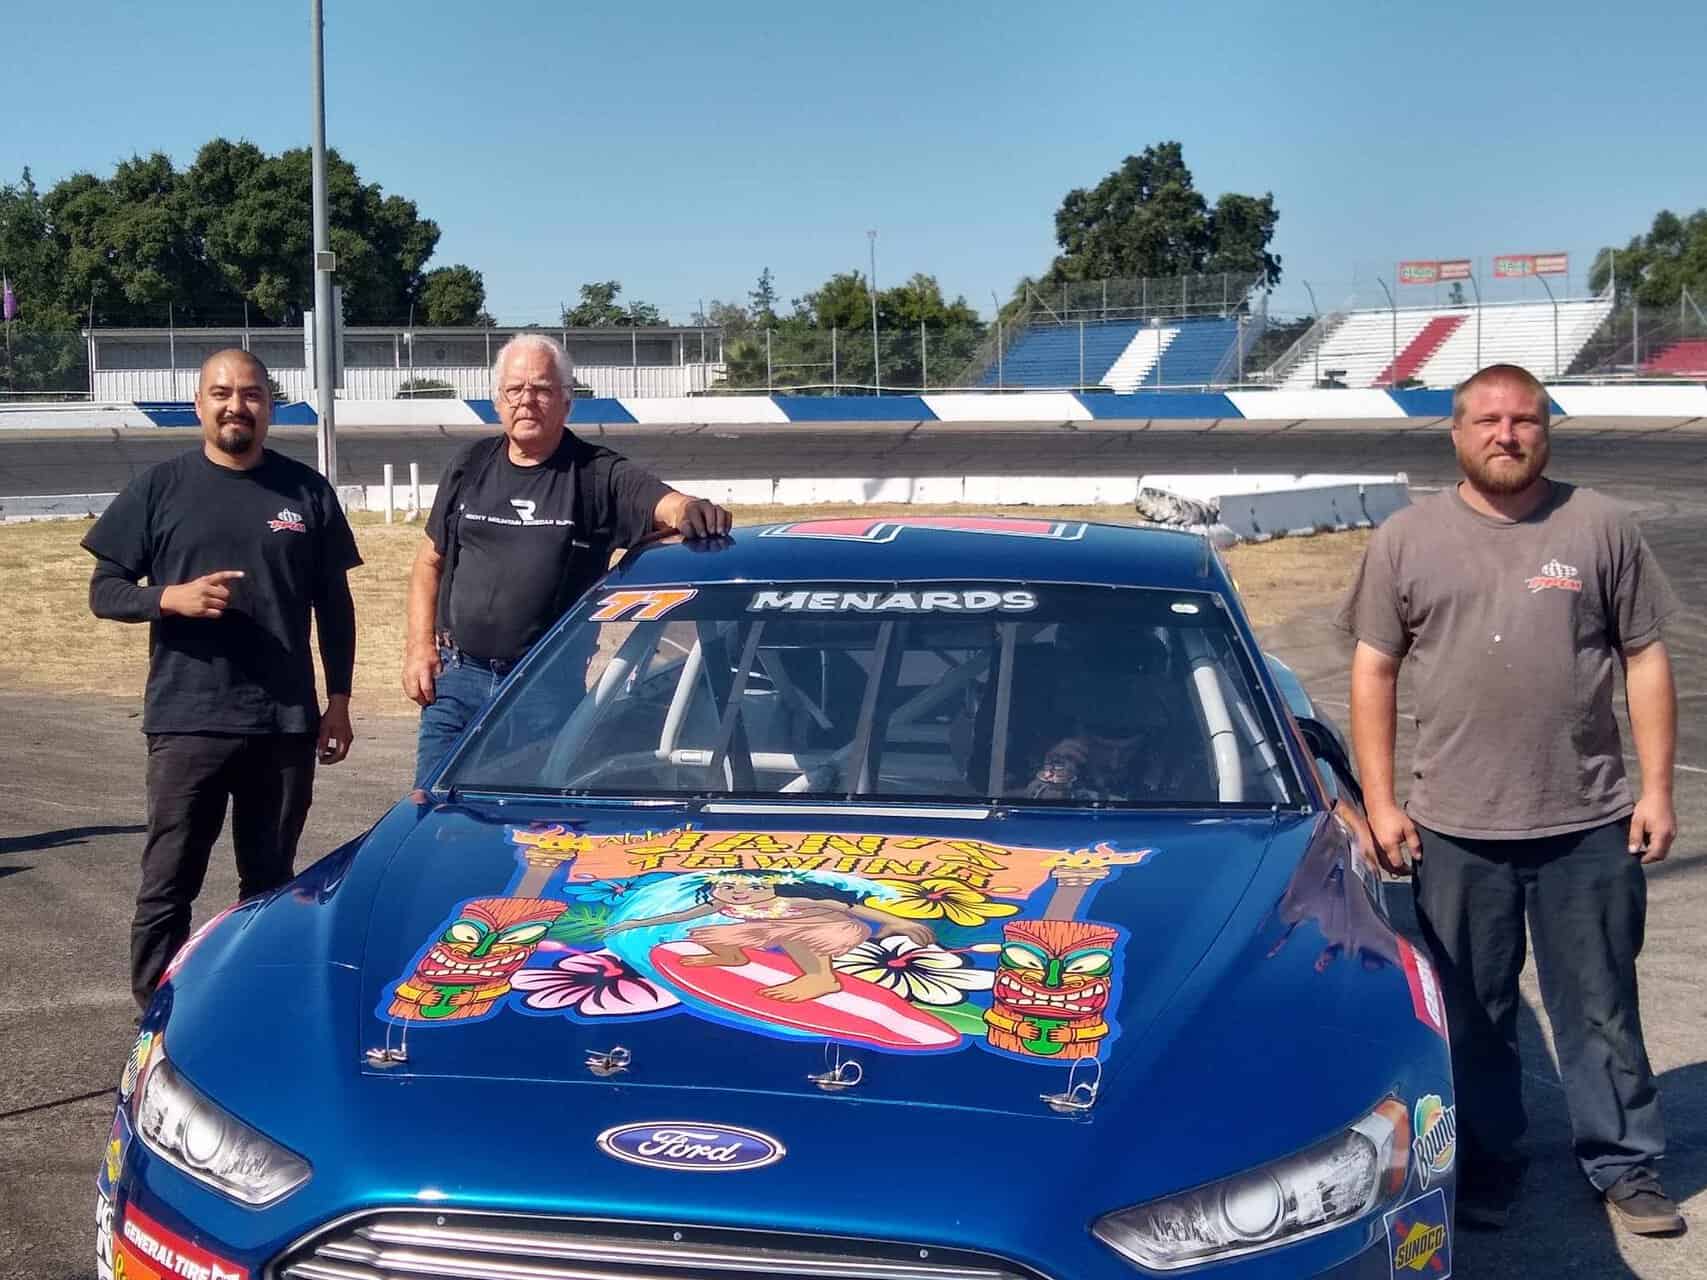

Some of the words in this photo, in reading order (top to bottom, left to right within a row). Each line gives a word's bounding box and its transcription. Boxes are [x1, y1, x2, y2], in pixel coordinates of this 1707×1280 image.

[588, 589, 698, 621] 77
[752, 591, 1035, 611] MENARDS
[628, 852, 992, 888] TOWING
[638, 1129, 742, 1162] Ford
[123, 1220, 175, 1269] GENERAL
[171, 1253, 213, 1280] TIRE
[1395, 1226, 1445, 1269] SUNOCO
